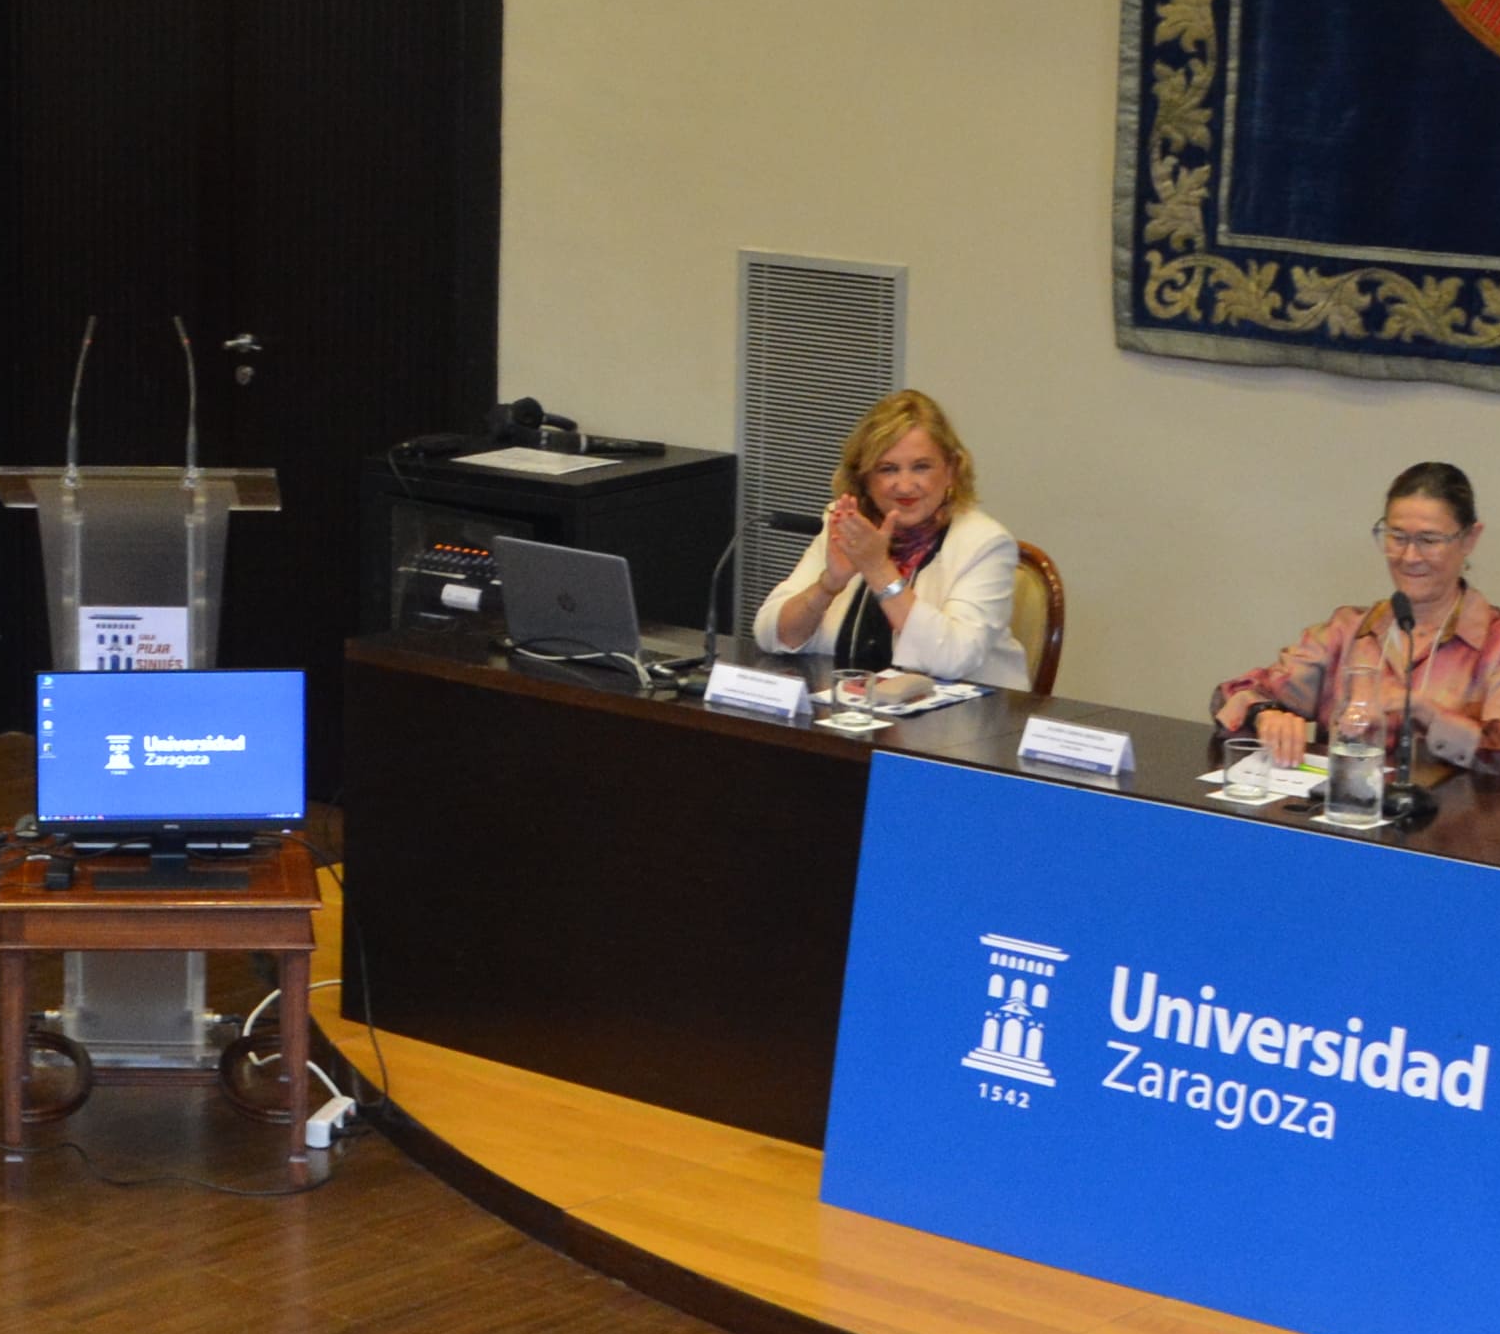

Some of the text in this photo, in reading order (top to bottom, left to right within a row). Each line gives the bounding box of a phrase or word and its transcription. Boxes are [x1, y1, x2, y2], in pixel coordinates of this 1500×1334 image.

[136, 643, 170, 655] PILAR
[143, 752, 211, 768] Zaragoza
[1109, 965, 1491, 1112] Universidad
[977, 1082, 1032, 1109] 1542
[1101, 1039, 1337, 1141] Zaragoza
